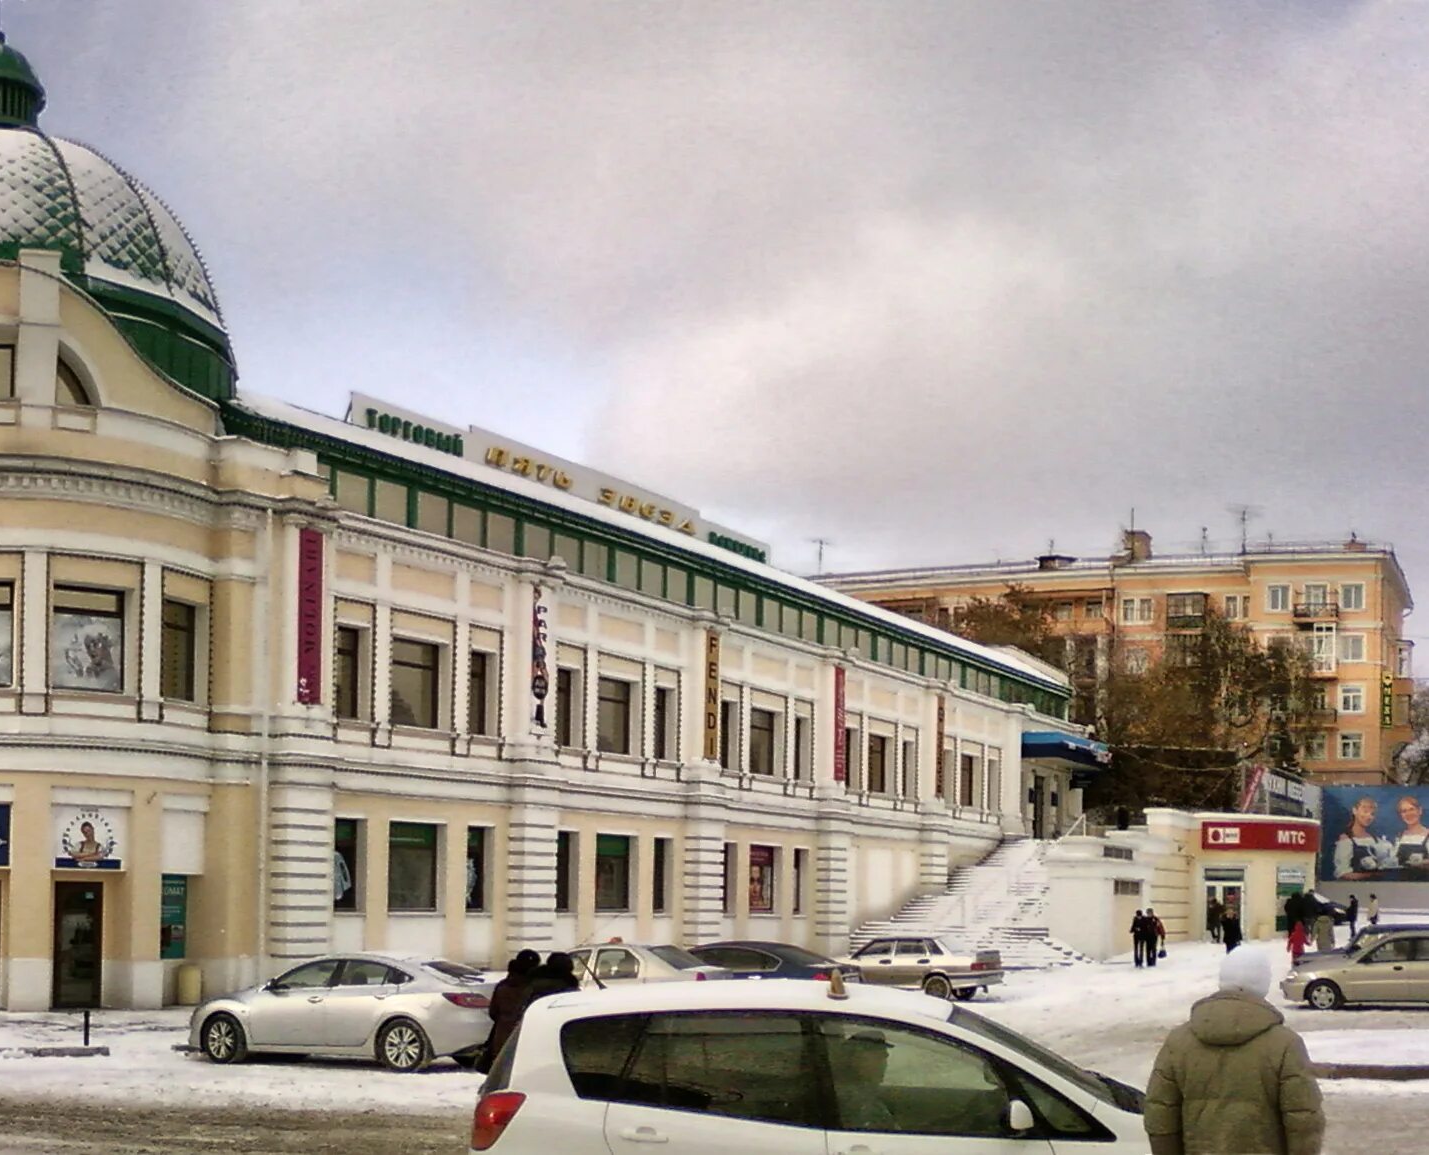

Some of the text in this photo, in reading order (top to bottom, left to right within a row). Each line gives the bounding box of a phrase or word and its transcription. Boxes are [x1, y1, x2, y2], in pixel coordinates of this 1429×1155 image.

[365, 407, 464, 458] ТОРГОВЫЙ
[484, 446, 697, 536] ПЯТЬ ЗВЕЗД
[304, 537, 318, 654] MOLINARI
[707, 636, 718, 756] FENDI
[1277, 829, 1307, 845] МТС
